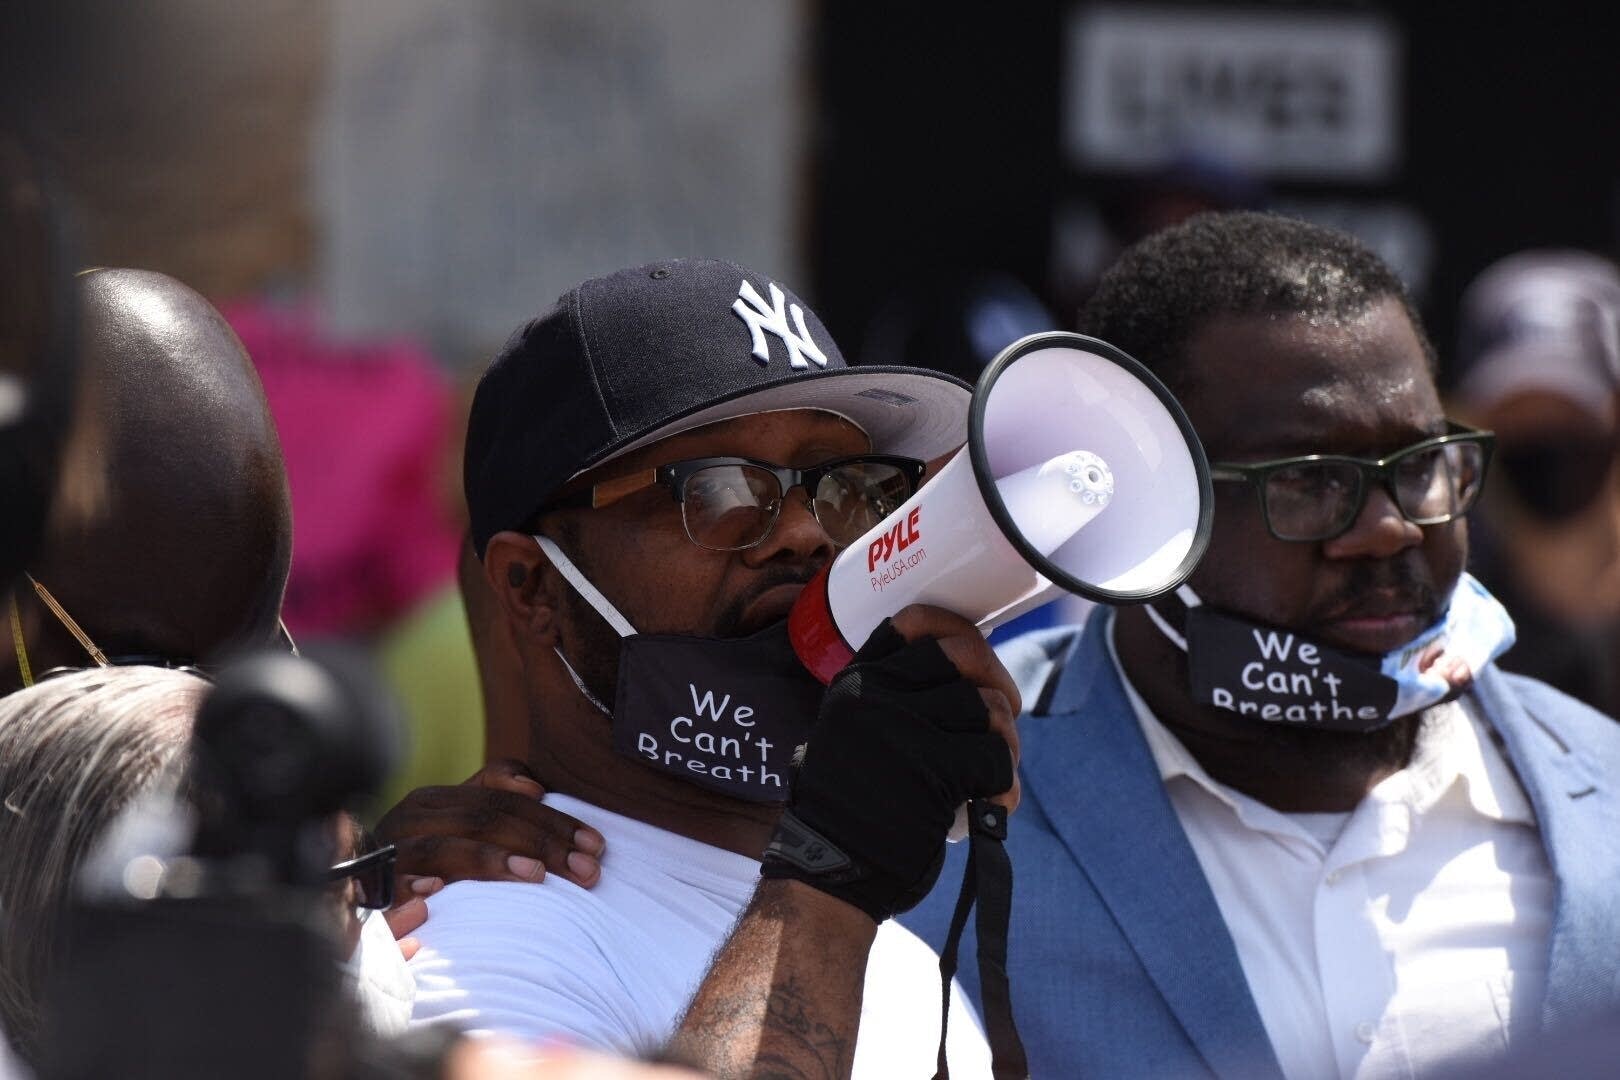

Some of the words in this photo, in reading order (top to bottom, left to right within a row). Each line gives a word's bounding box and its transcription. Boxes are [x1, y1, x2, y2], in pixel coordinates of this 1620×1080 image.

[732, 279, 828, 369] NY
[867, 506, 921, 573] PYLE
[870, 548, 927, 592] PyleUSA.com
[1252, 628, 1322, 665] We
[1241, 662, 1342, 697] Can't
[689, 683, 756, 727] We
[1212, 687, 1380, 722] Breathe
[637, 732, 789, 787] Breath
[670, 716, 774, 762] Can't
